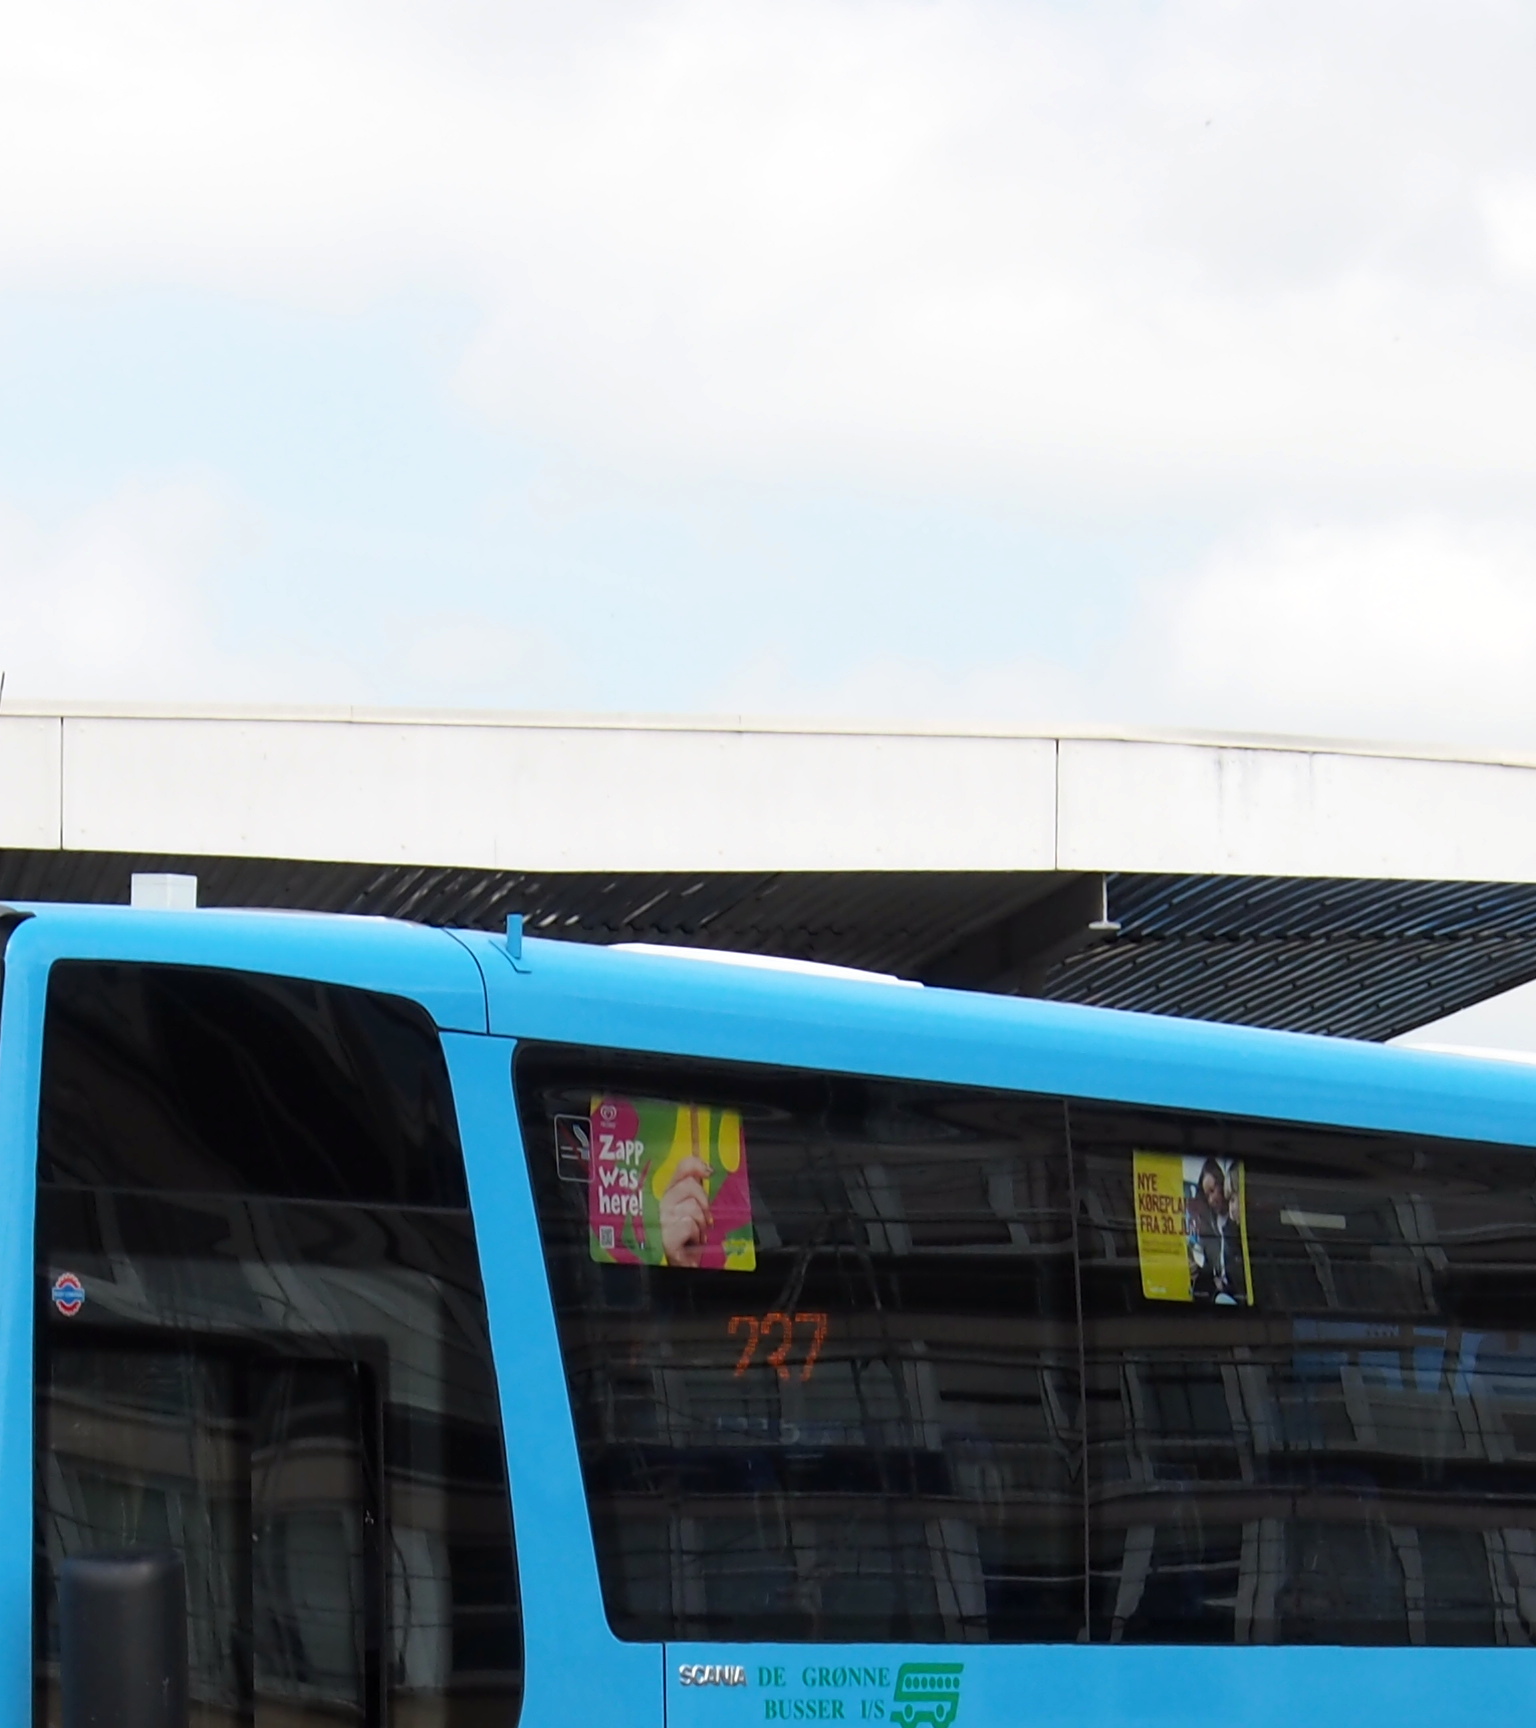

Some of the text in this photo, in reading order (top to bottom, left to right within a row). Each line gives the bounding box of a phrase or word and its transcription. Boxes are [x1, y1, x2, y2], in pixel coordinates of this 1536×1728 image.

[599, 1134, 644, 1165] Zapp
[1137, 1172, 1157, 1191] NYE
[598, 1185, 643, 1215] here!
[1140, 1214, 1160, 1234] FRA
[679, 1664, 747, 1686] SCANIA
[758, 1666, 891, 1688] DE GRØNNE
[765, 1699, 885, 1720] BUSSER I/S
